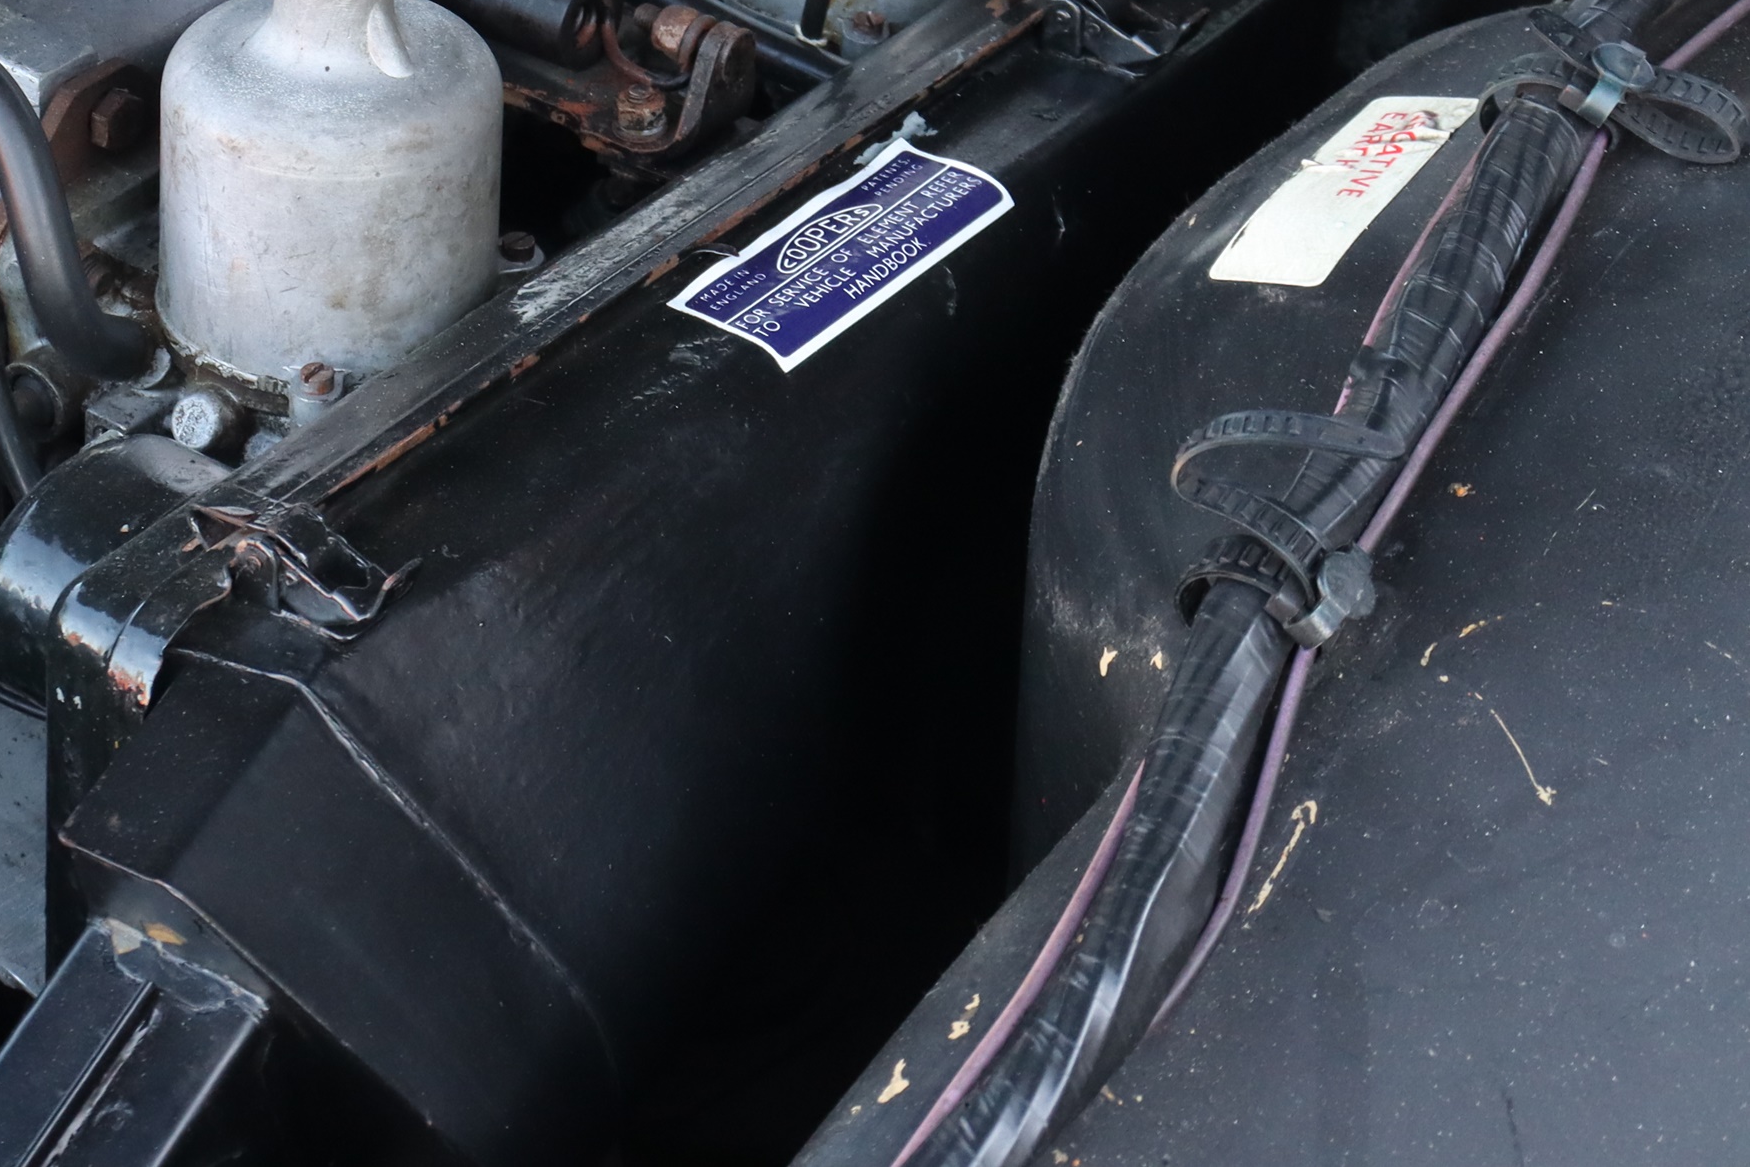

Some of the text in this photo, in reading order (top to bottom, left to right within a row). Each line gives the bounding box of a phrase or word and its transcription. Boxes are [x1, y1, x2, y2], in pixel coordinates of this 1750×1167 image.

[874, 164, 923, 196] PENDING
[735, 171, 964, 330] FOR SERVICE OF ELEMENT REFER
[752, 176, 983, 337] TO VEHICLE MANUFACTURERS
[699, 269, 750, 303] MADE IN
[709, 273, 767, 311] ENGLAND
